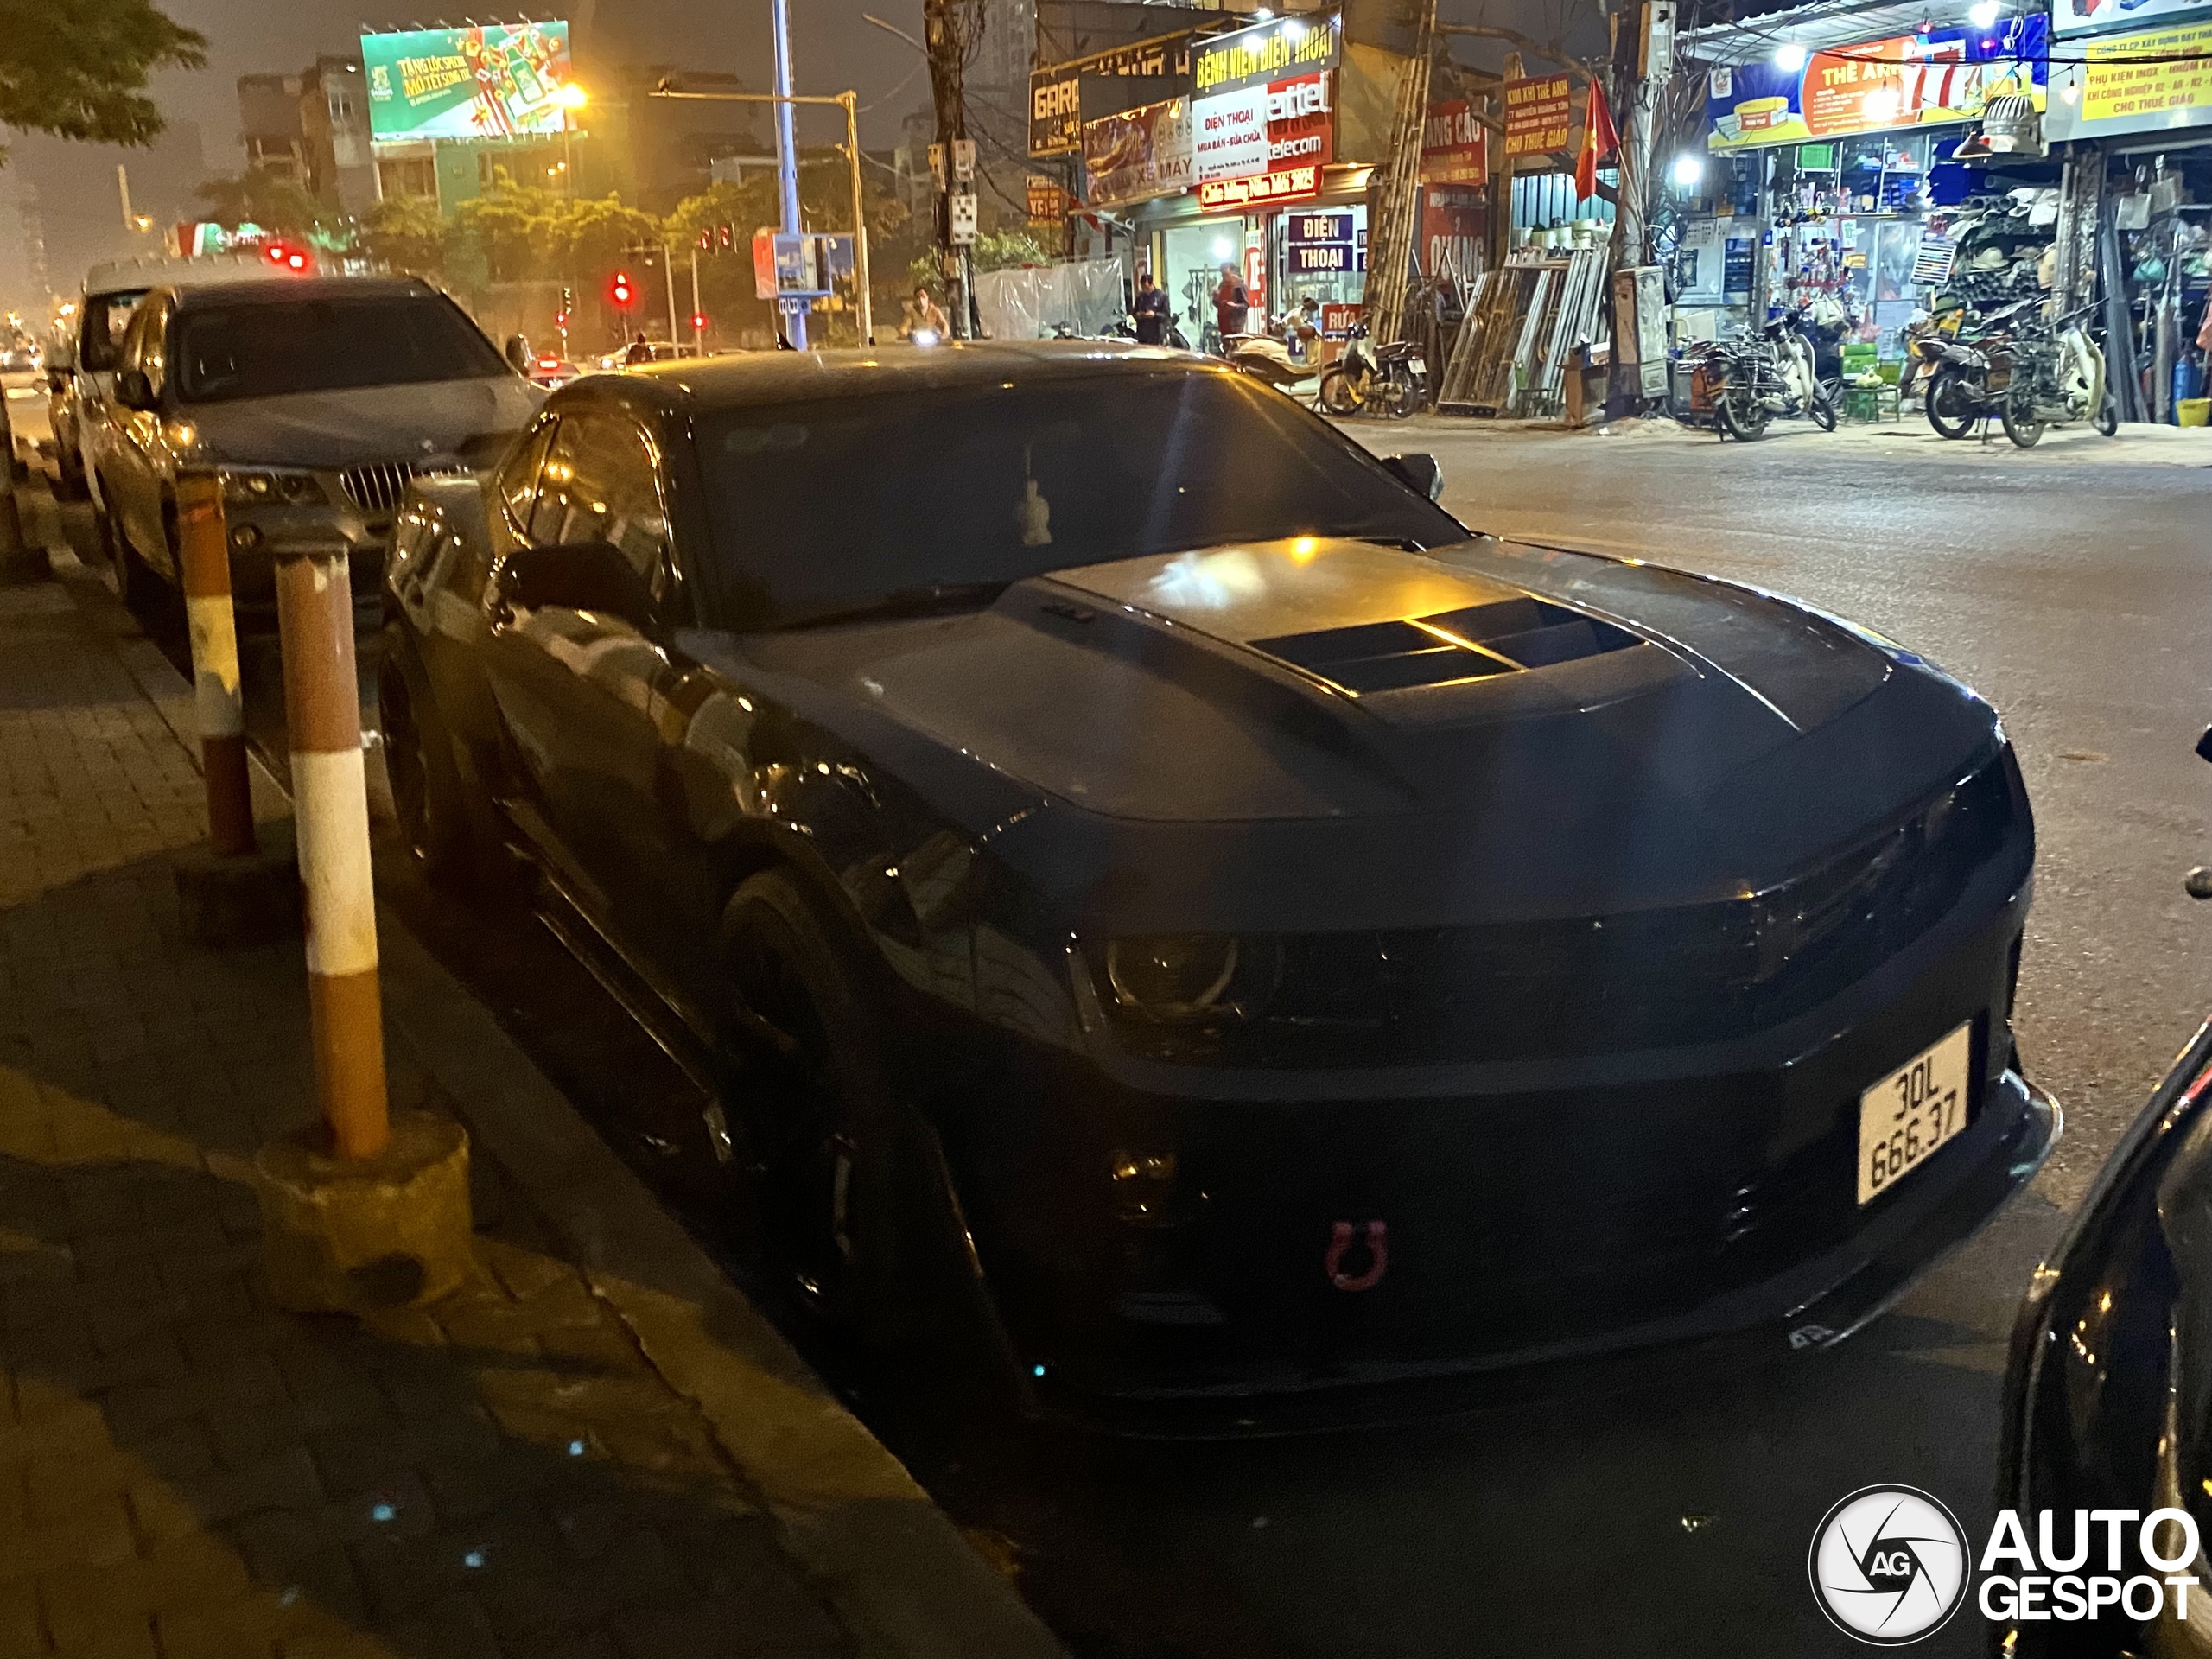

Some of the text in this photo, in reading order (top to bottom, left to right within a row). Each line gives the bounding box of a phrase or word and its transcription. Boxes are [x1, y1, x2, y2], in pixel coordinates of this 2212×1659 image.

[1197, 48, 1227, 93] BỆNH
[2113, 101, 2135, 113] CHO
[1205, 108, 1254, 132] ĐIỆN THOẠI
[1198, 141, 1211, 153] MUA
[1267, 136, 1321, 161] telecom
[1303, 215, 1339, 241] ĐIỆN
[1300, 248, 1344, 271] THOẠI
[1894, 1055, 1939, 1122] 30L
[1872, 1088, 1956, 1189] 666.37
